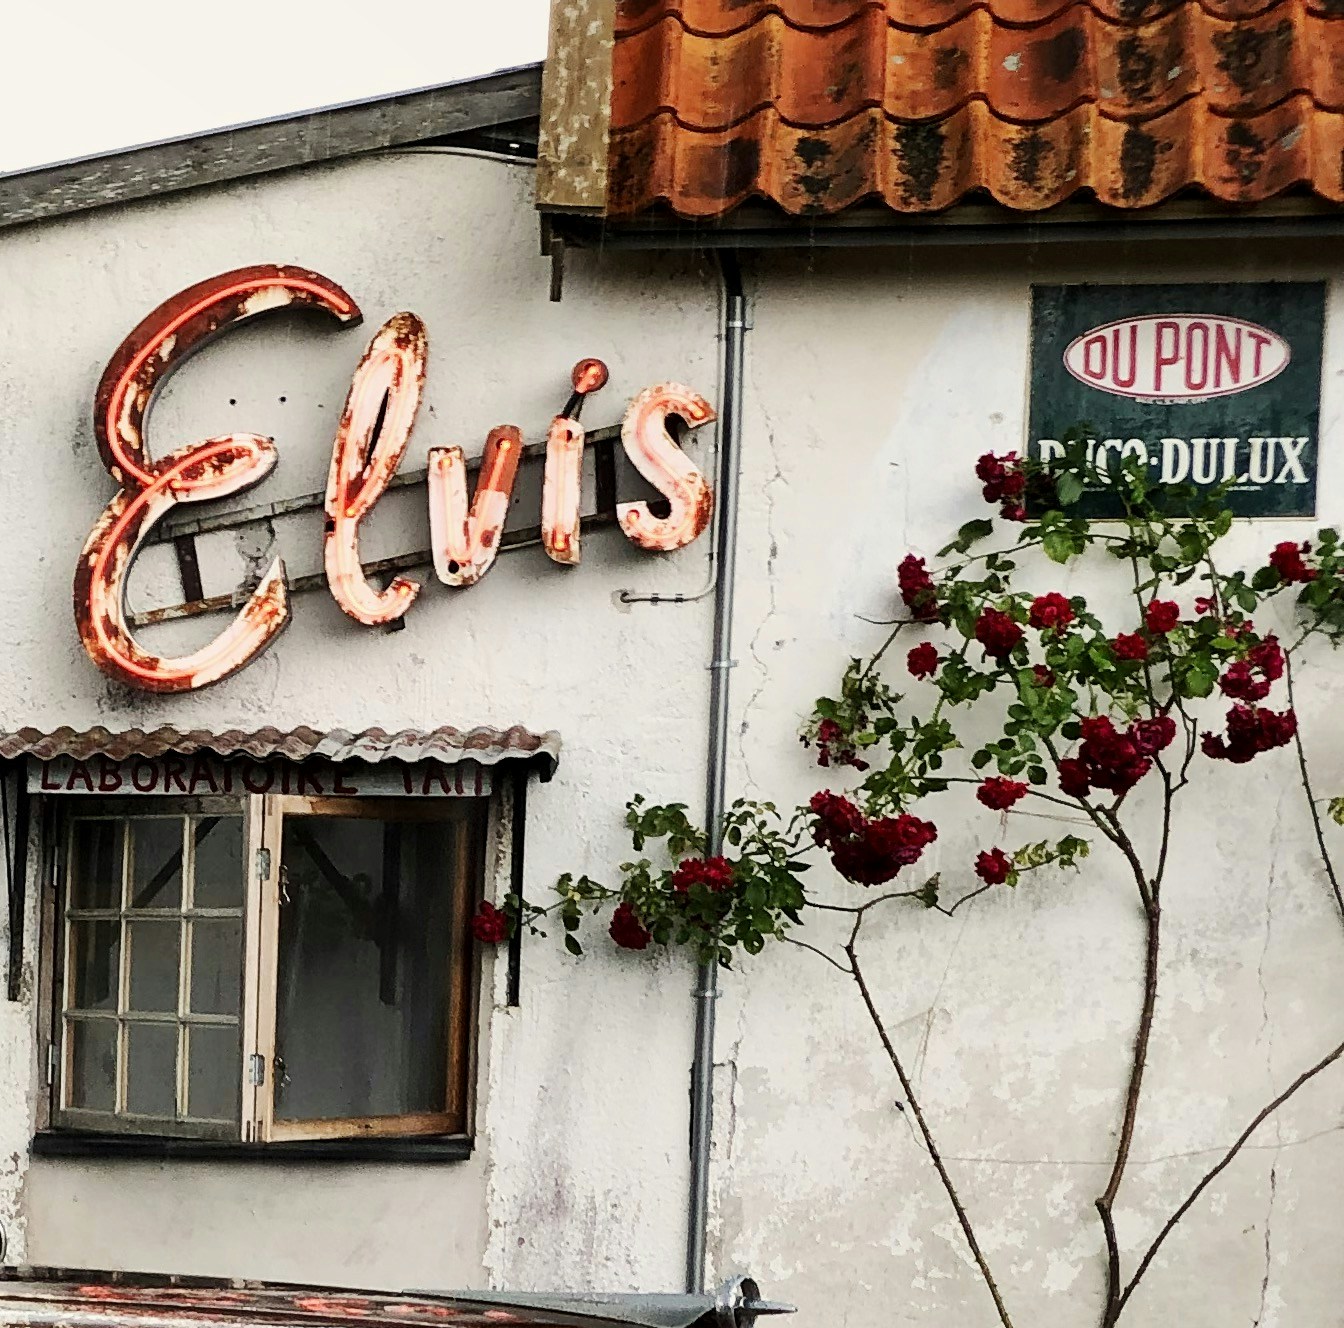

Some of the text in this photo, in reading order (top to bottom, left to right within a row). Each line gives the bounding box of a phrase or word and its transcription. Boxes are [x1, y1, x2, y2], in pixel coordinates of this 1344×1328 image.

[73, 263, 716, 694] Elvis
[1083, 321, 1272, 392] DU PONT
